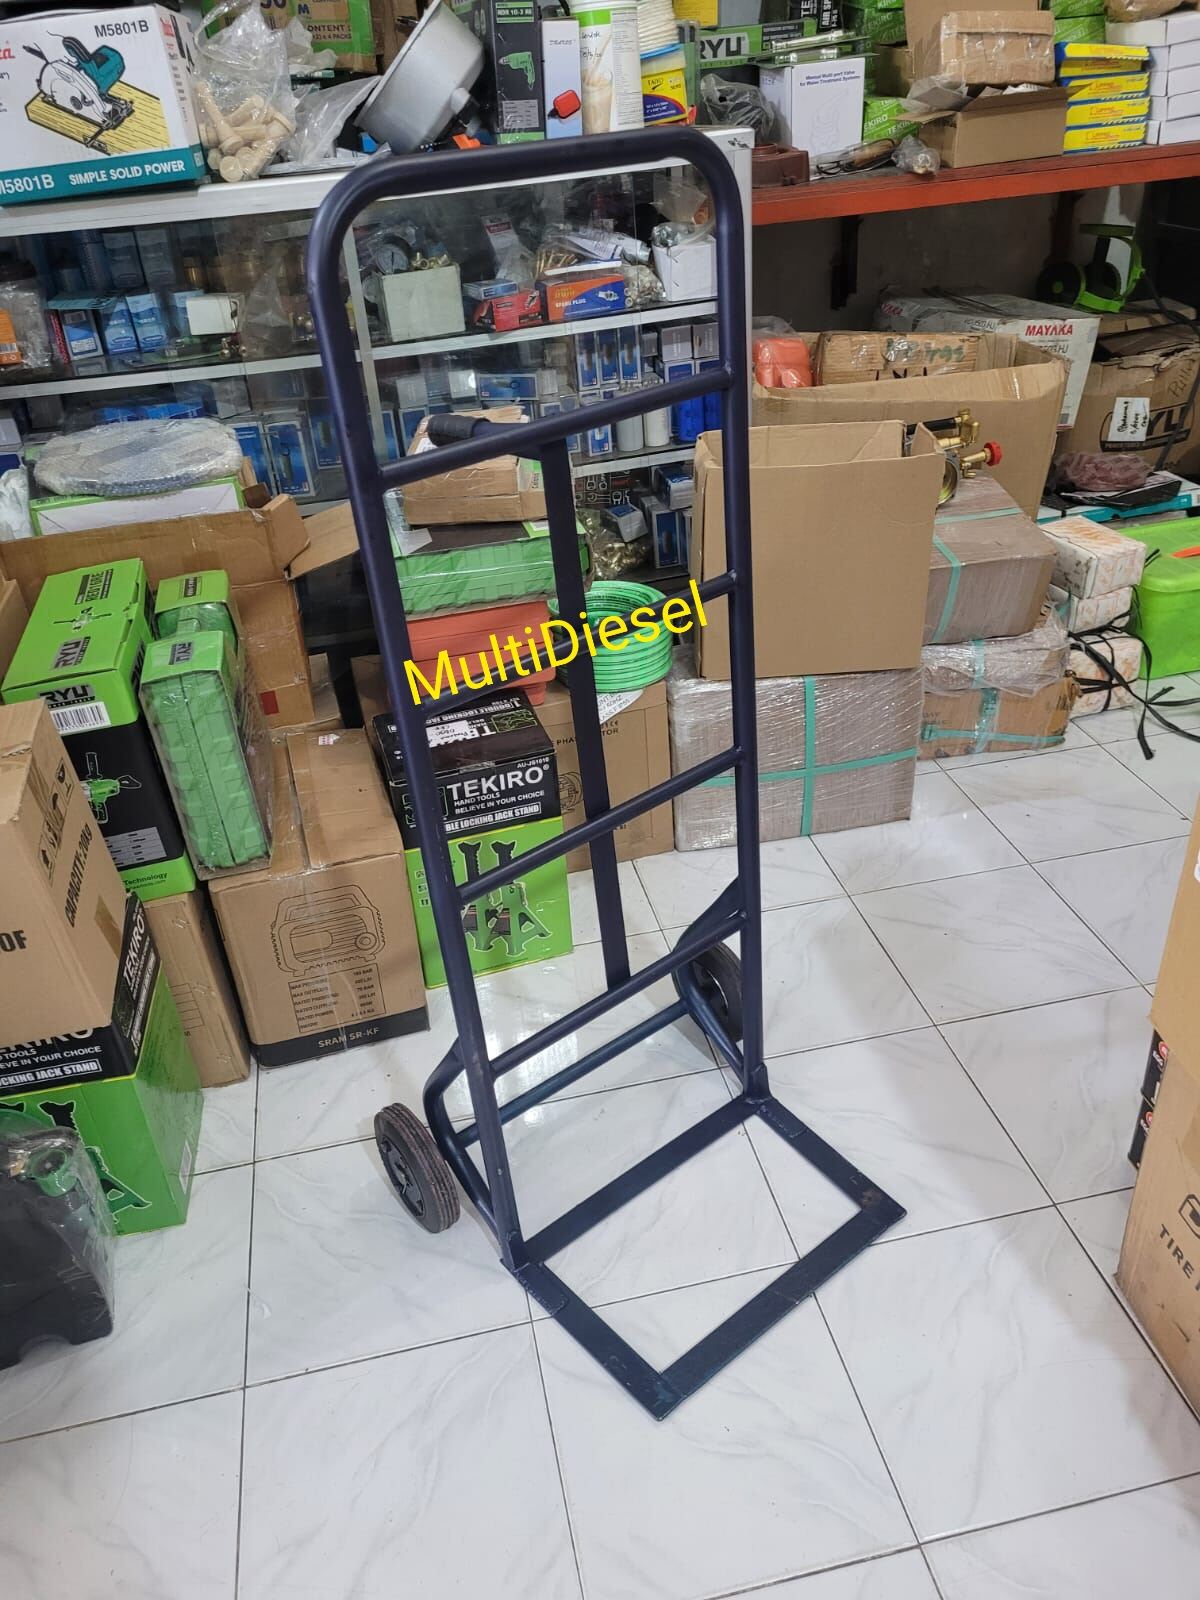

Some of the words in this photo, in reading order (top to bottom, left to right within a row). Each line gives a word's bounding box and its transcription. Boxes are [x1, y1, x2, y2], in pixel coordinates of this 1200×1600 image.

[95, 19, 149, 38] M5801B
[307, 24, 345, 32] ONTENT
[864, 113, 888, 130] EKIRO
[69, 170, 108, 187] SIMPLE
[110, 165, 142, 180] SOLID
[145, 160, 186, 176] POWER
[1025, 324, 1073, 336] MAYAKA
[54, 640, 82, 669] RYU
[39, 685, 90, 702] RYU
[556, 736, 577, 746] PHA
[600, 727, 619, 737] TOR
[447, 766, 544, 801] TEKIRO
[454, 796, 476, 807] HAND
[476, 792, 501, 802] TOOLS
[455, 803, 486, 815] BELIEVE
[487, 800, 495, 808] IN
[496, 796, 517, 806] YOUR
[517, 790, 545, 801] CHOICE
[445, 822, 460, 832] BLE
[460, 814, 494, 829] LOCKING
[495, 810, 514, 822] JACK
[514, 804, 540, 817] STAND
[318, 1035, 346, 1048] SRAM
[349, 1027, 380, 1040] SR-KF
[4, 1048, 37, 1060] TOOLS
[21, 1058, 32, 1066] IN
[32, 1052, 62, 1064] YOUR
[63, 1045, 102, 1058] CHOICE
[36, 1067, 63, 1080] JACK
[63, 1061, 98, 1076] STAND
[1160, 1223, 1194, 1279] TIRE
